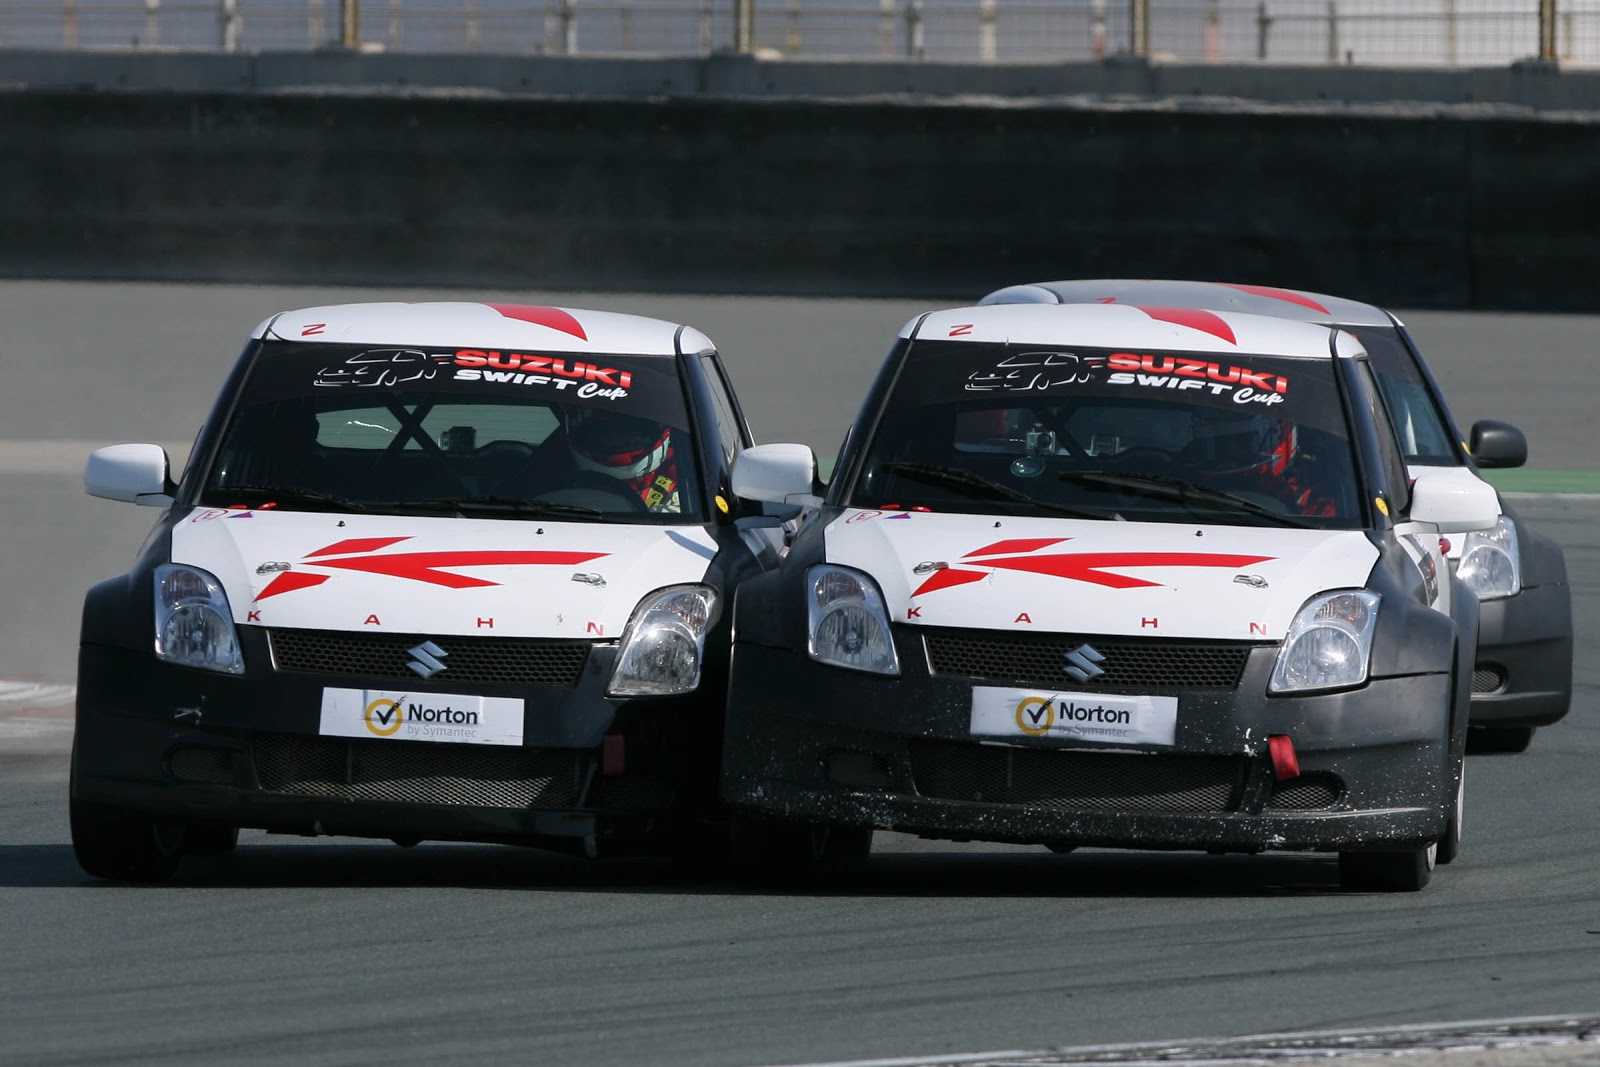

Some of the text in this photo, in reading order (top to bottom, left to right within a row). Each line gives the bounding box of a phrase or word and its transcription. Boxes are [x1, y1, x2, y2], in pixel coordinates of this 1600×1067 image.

[454, 349, 632, 389] SUZUKI
[1107, 353, 1288, 394] SUZUKI
[453, 369, 629, 400] SWIFT Cup
[1107, 372, 1284, 406] SWIFT Cup
[408, 703, 478, 724] Norton
[1059, 702, 1130, 724] Norton
[407, 724, 477, 738] by Symantec
[1059, 723, 1128, 738] by Symantec
